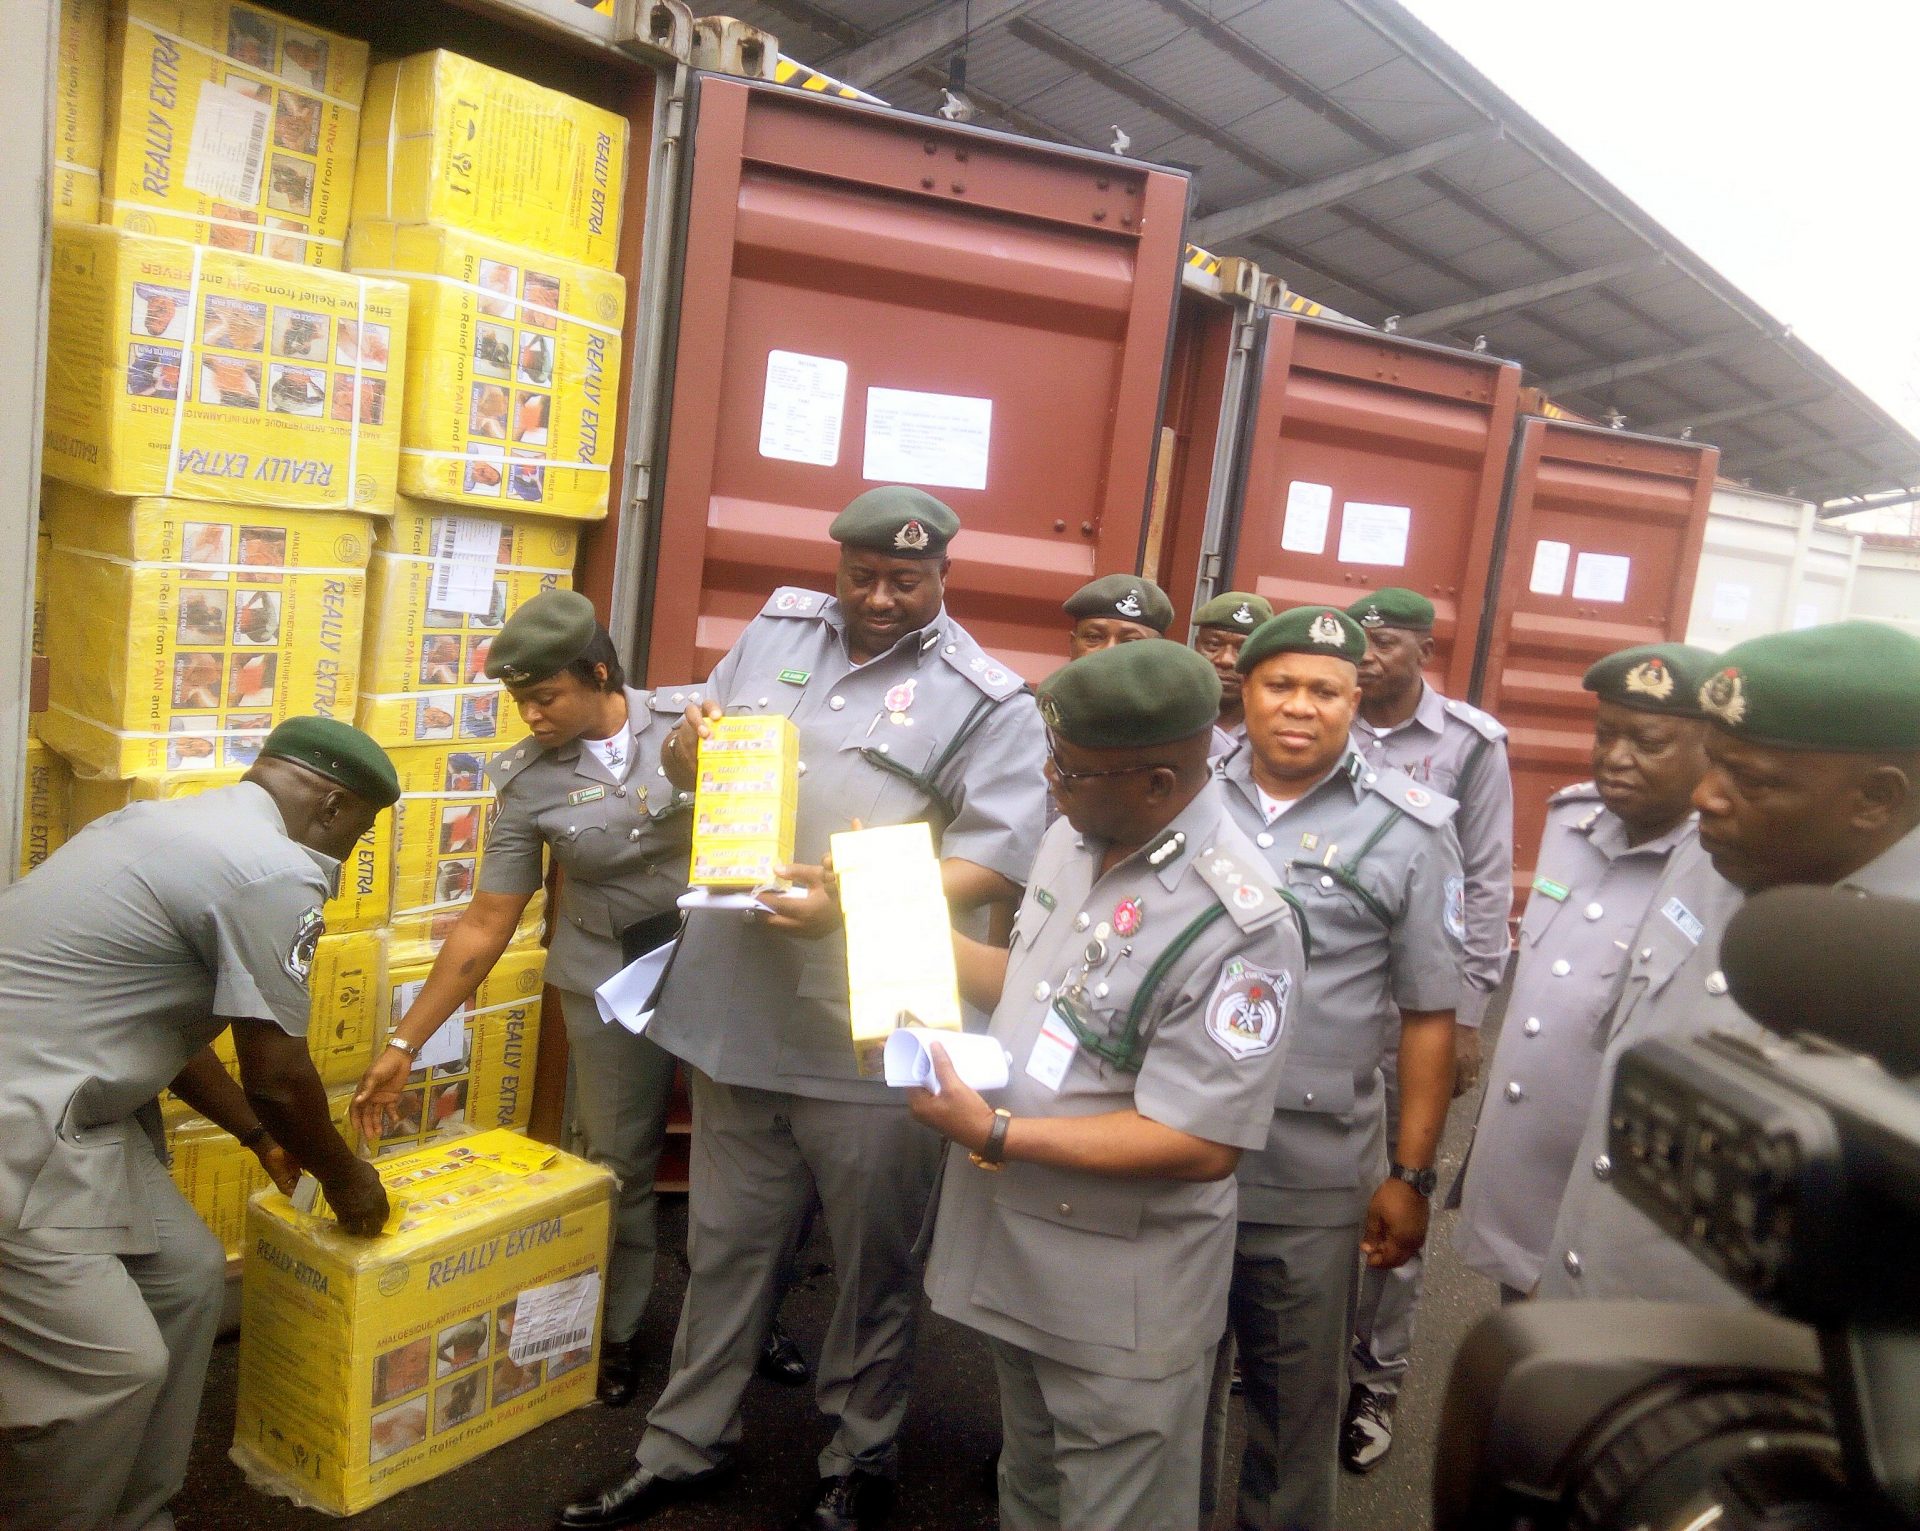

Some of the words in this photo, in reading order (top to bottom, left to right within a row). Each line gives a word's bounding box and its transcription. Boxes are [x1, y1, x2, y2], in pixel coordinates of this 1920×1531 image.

[150, 32, 181, 110] EXTRA
[143, 110, 174, 198] REALLY
[325, 122, 338, 154] PAIN
[321, 157, 335, 188] from
[594, 131, 611, 188] REALLY
[588, 188, 606, 236] EXTRA
[265, 284, 296, 302] from
[296, 289, 336, 309] Relief
[460, 254, 474, 310] Effecive
[340, 298, 393, 318] Effecive
[458, 313, 470, 350] Relief
[456, 350, 468, 381] from
[583, 332, 606, 406] REALLY
[453, 385, 464, 415] PAIN
[148, 441, 173, 451] ablets
[452, 418, 460, 442] and
[578, 408, 600, 465] EXTRA
[175, 447, 250, 478] EXTRA
[253, 456, 333, 487] REALLY
[447, 445, 459, 488] FVER
[160, 520, 174, 579] Effectie
[410, 517, 424, 569] Effectie
[158, 583, 170, 621] Relief
[408, 572, 419, 607] Relief
[317, 578, 346, 653] REALLY
[405, 608, 417, 637] from
[155, 622, 168, 655] from
[402, 639, 415, 671] PAIN
[152, 659, 166, 691] PAIN
[312, 659, 339, 720] EXTRA
[401, 672, 412, 693] and
[149, 695, 161, 719] and
[399, 703, 411, 738] EVER
[147, 723, 161, 768] FVER
[31, 765, 50, 820] REALLY
[357, 850, 375, 895] EXTRA
[503, 1008, 526, 1070] REALLY
[497, 1075, 520, 1127] EXTRA
[256, 1238, 293, 1274] REALLY
[294, 1260, 329, 1296] EXTRA
[427, 1238, 500, 1291] REALLY
[505, 1215, 563, 1259] EXTRA
[428, 1431, 467, 1457] Relief
[467, 1420, 494, 1441] from
[496, 1403, 525, 1424] PAIN
[527, 1393, 548, 1410] and
[550, 1371, 588, 1397] FEVER
